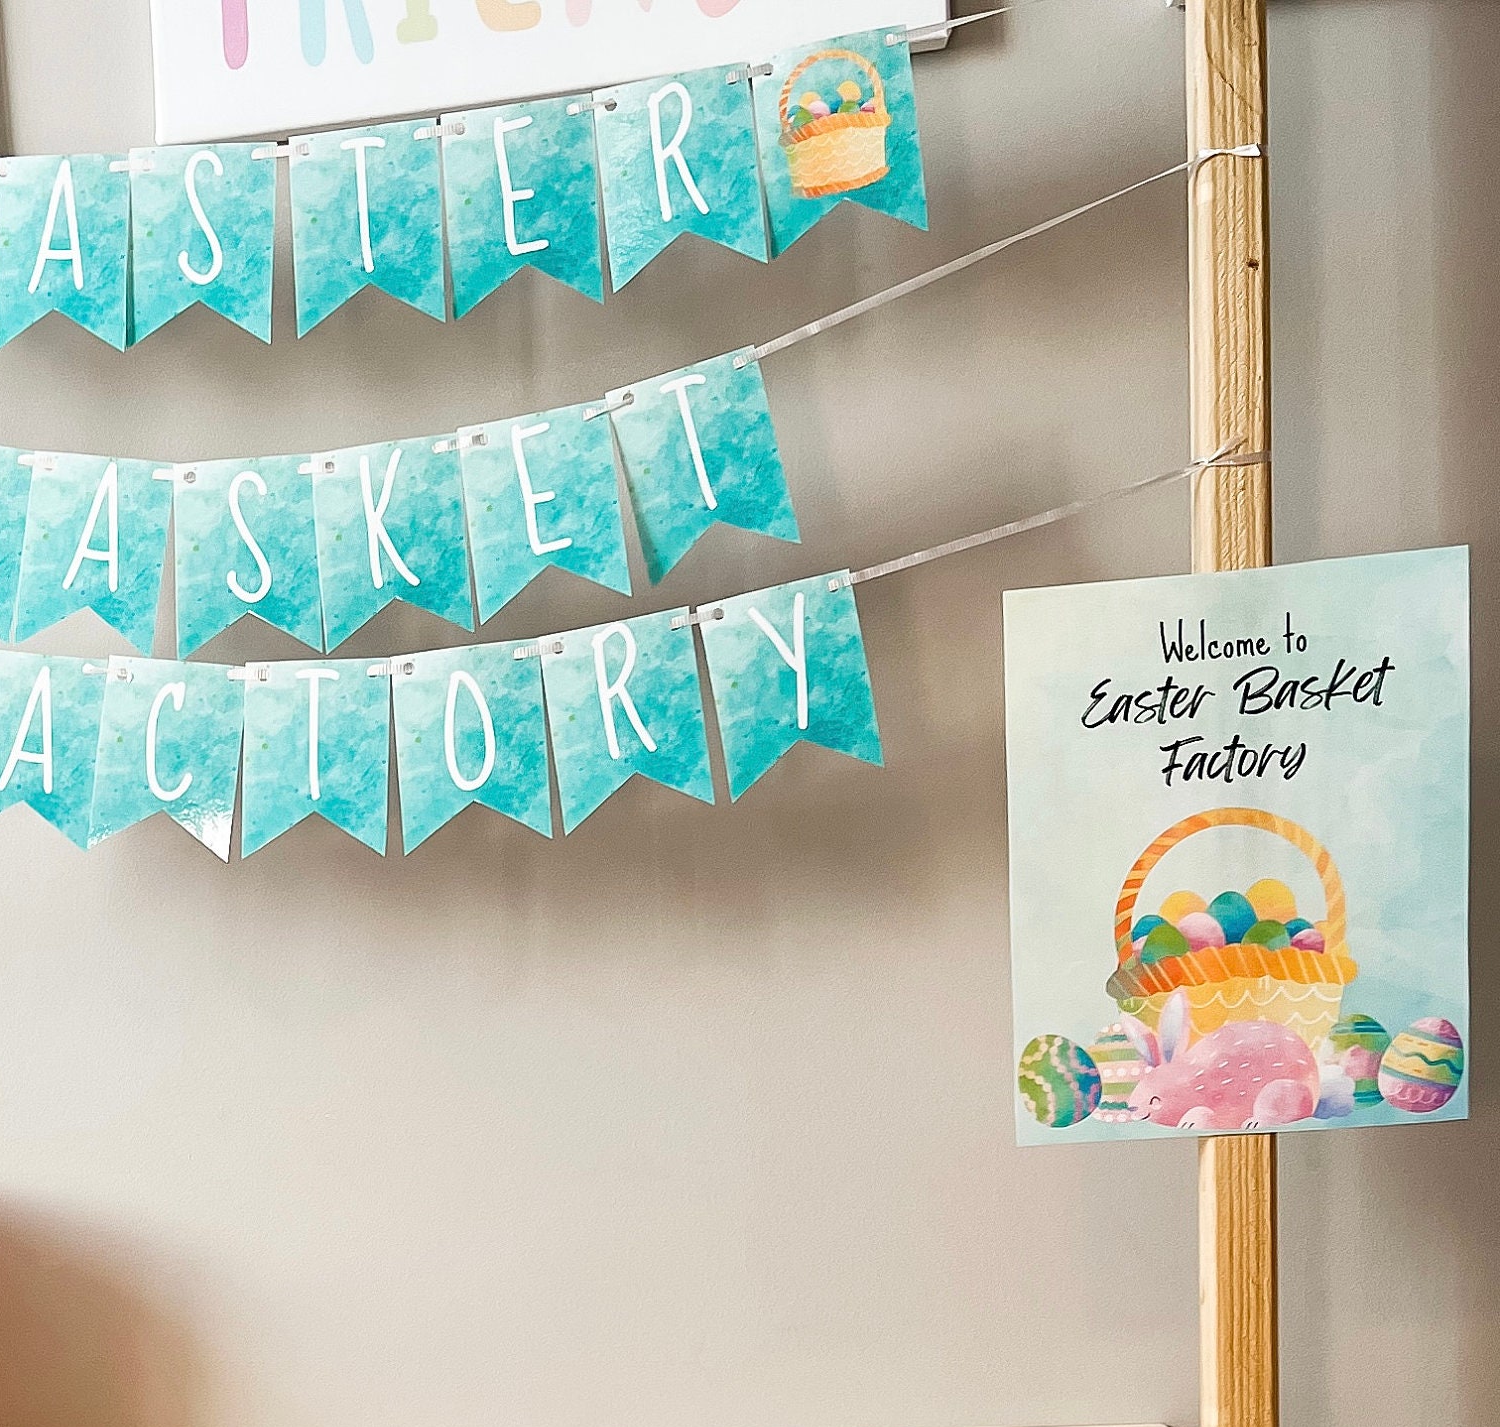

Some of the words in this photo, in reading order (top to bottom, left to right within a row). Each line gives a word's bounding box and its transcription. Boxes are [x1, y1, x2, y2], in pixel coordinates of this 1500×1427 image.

[1159, 619, 1271, 664] Welcome
[1282, 612, 1308, 653] to
[1081, 676, 1216, 728] Easter
[1232, 656, 1396, 716] Basket
[1159, 734, 1307, 787] Factory
